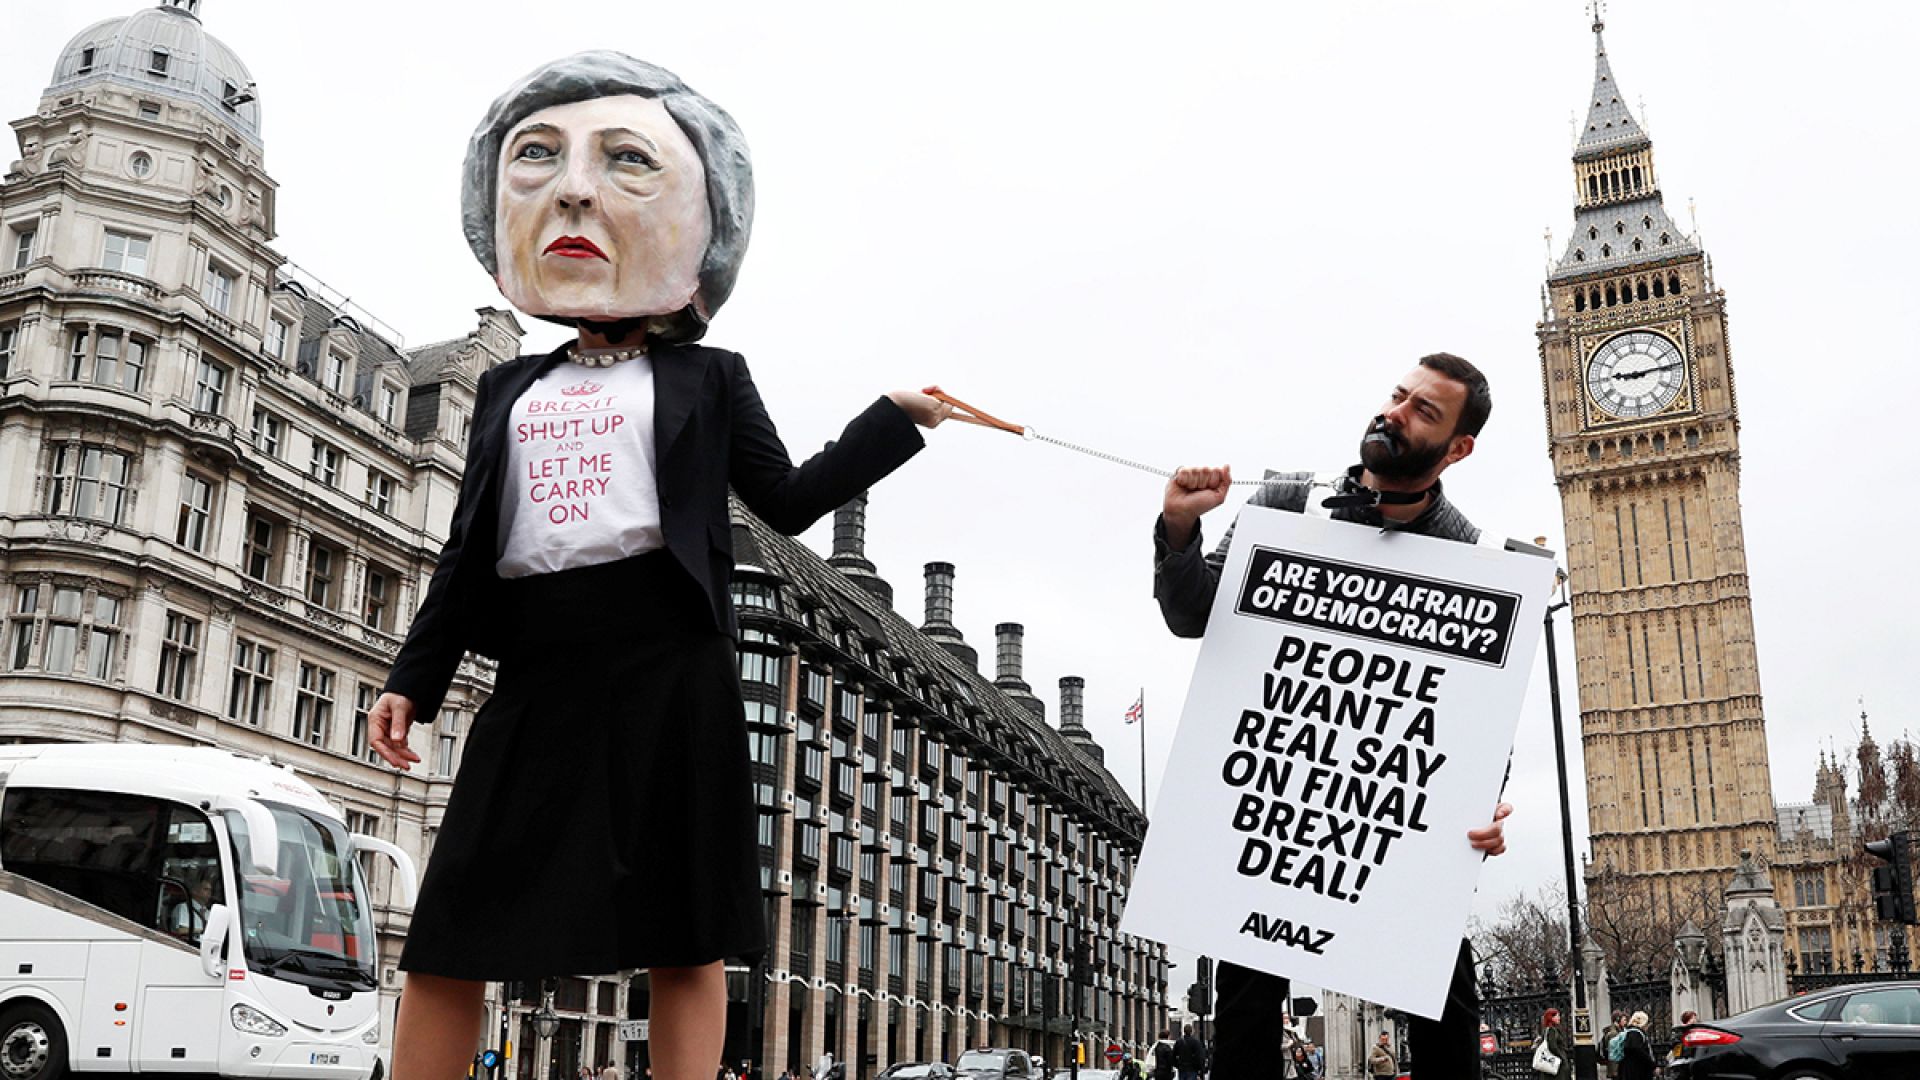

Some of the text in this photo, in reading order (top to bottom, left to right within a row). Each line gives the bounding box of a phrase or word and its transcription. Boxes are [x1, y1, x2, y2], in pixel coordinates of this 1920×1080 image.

[517, 414, 625, 443] SHUT UP
[527, 396, 618, 413] BREXIT
[528, 453, 612, 480] LET ME
[556, 441, 585, 452] AND
[529, 476, 610, 503] CARRY
[548, 502, 589, 525] ON
[1252, 585, 1498, 654] OF DEMOCRACY?
[1263, 559, 1498, 625] ARE YOU AFRAID
[1273, 635, 1446, 705] PEOPLE
[1263, 671, 1435, 747] WANT A
[1232, 709, 1447, 789] REAL SAY
[1222, 750, 1429, 833] ON FINAL
[1231, 792, 1404, 866] BREXIT
[1236, 837, 1371, 904] DEAL!
[1239, 911, 1335, 956] AVAAZ
